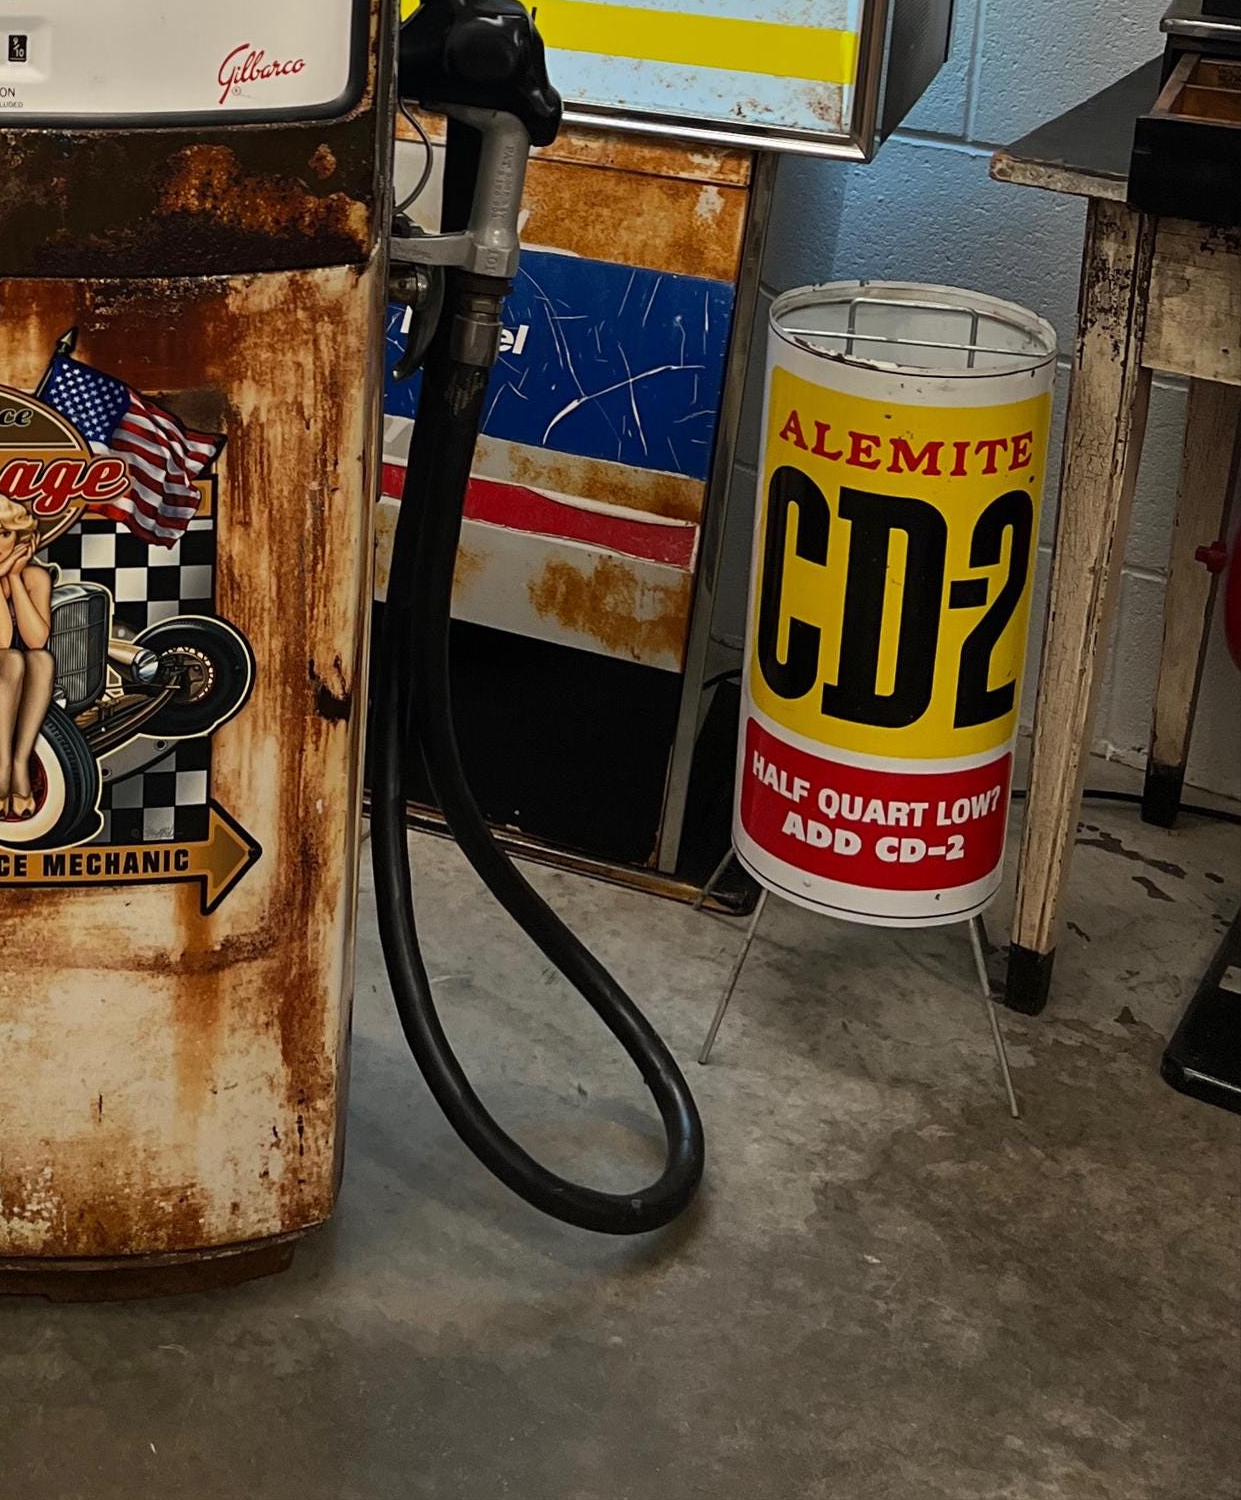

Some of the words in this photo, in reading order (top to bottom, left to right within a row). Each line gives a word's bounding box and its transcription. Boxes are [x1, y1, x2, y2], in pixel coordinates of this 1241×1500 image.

[218, 43, 306, 105] Gilbarco
[778, 408, 1035, 478] ALEMITE
[758, 464, 1035, 731] CD-2
[751, 748, 810, 803] HALF
[818, 786, 929, 828] QUART
[936, 784, 1001, 828] LOW?
[43, 849, 190, 879] MECHANIC
[781, 808, 862, 857] ADD
[876, 833, 966, 861] CD-2
